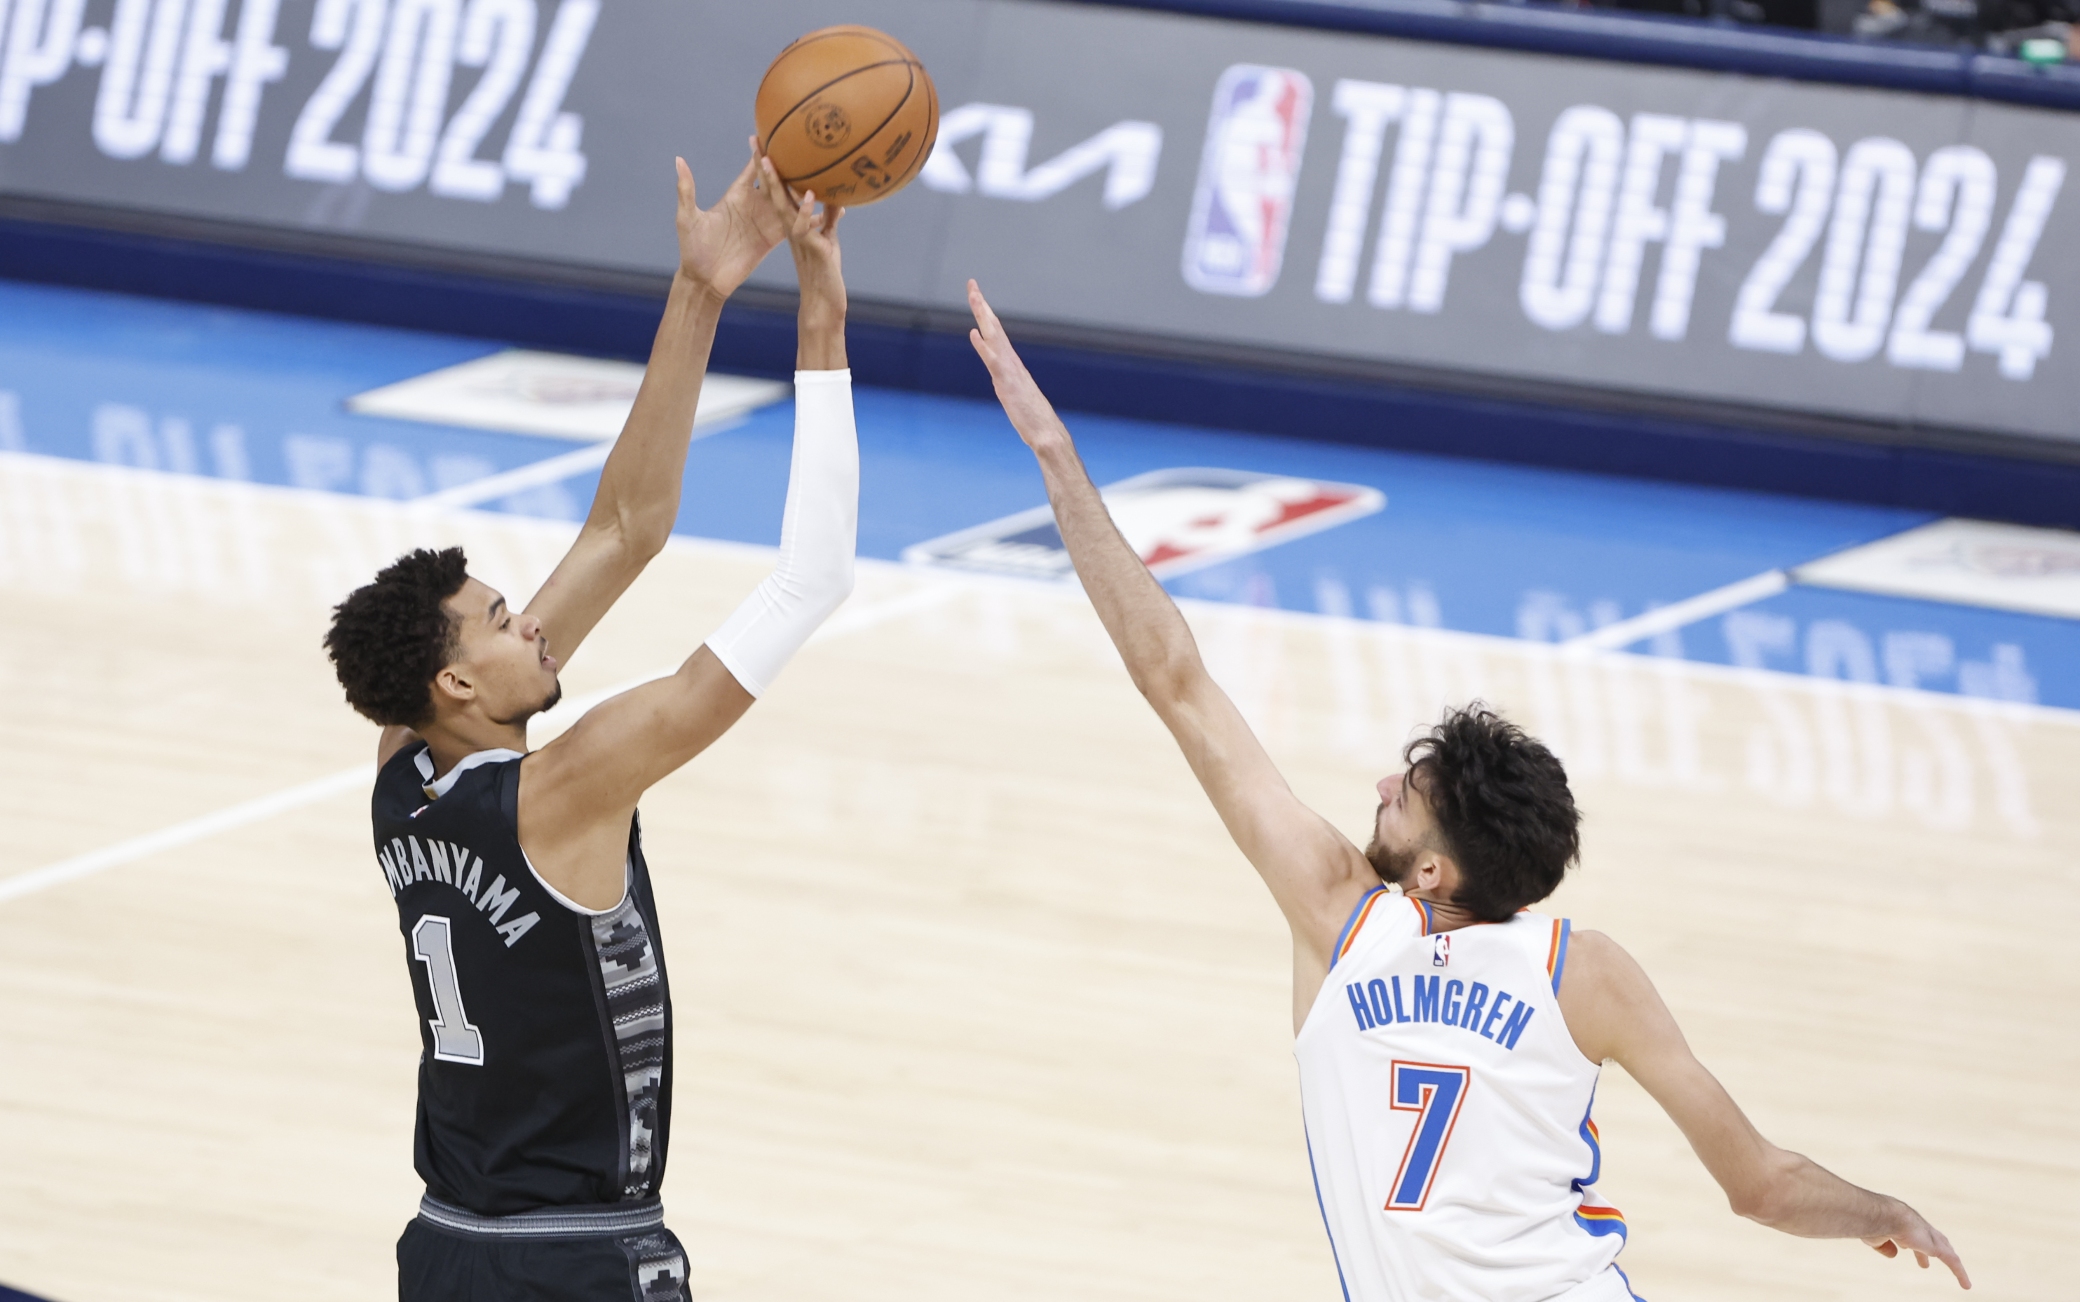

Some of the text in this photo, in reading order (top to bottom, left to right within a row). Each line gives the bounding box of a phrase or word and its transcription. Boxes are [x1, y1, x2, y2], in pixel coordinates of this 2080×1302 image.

[284, 0, 602, 210] 2024
[1729, 128, 2067, 381] 2024
[379, 835, 541, 949] MBANYAMA
[412, 914, 485, 1067] 1
[1346, 975, 1536, 1051] HOLMGREN
[1384, 1060, 1471, 1212] 7
